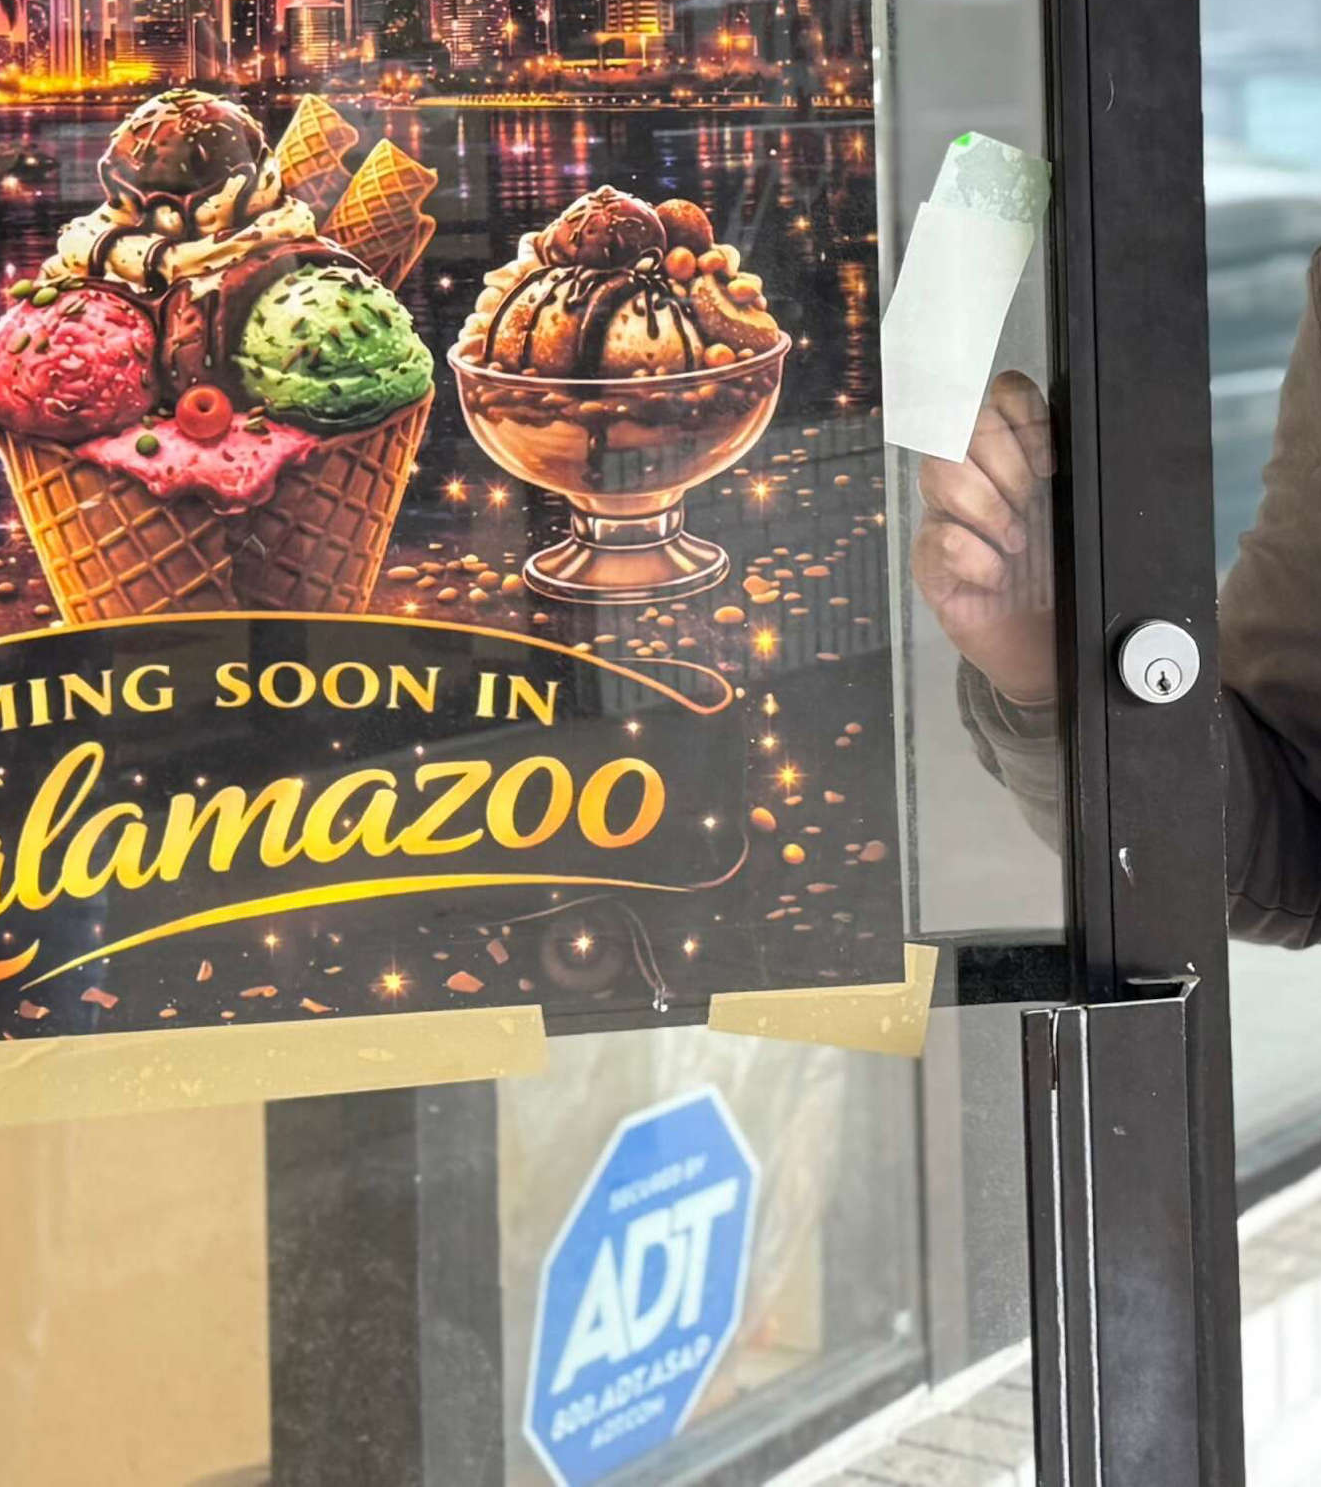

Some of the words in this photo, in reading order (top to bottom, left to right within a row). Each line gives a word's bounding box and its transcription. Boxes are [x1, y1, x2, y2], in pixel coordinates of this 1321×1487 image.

[214, 660, 442, 711] SOON
[476, 671, 560, 727] IN
[550, 1176, 740, 1397] ADT
